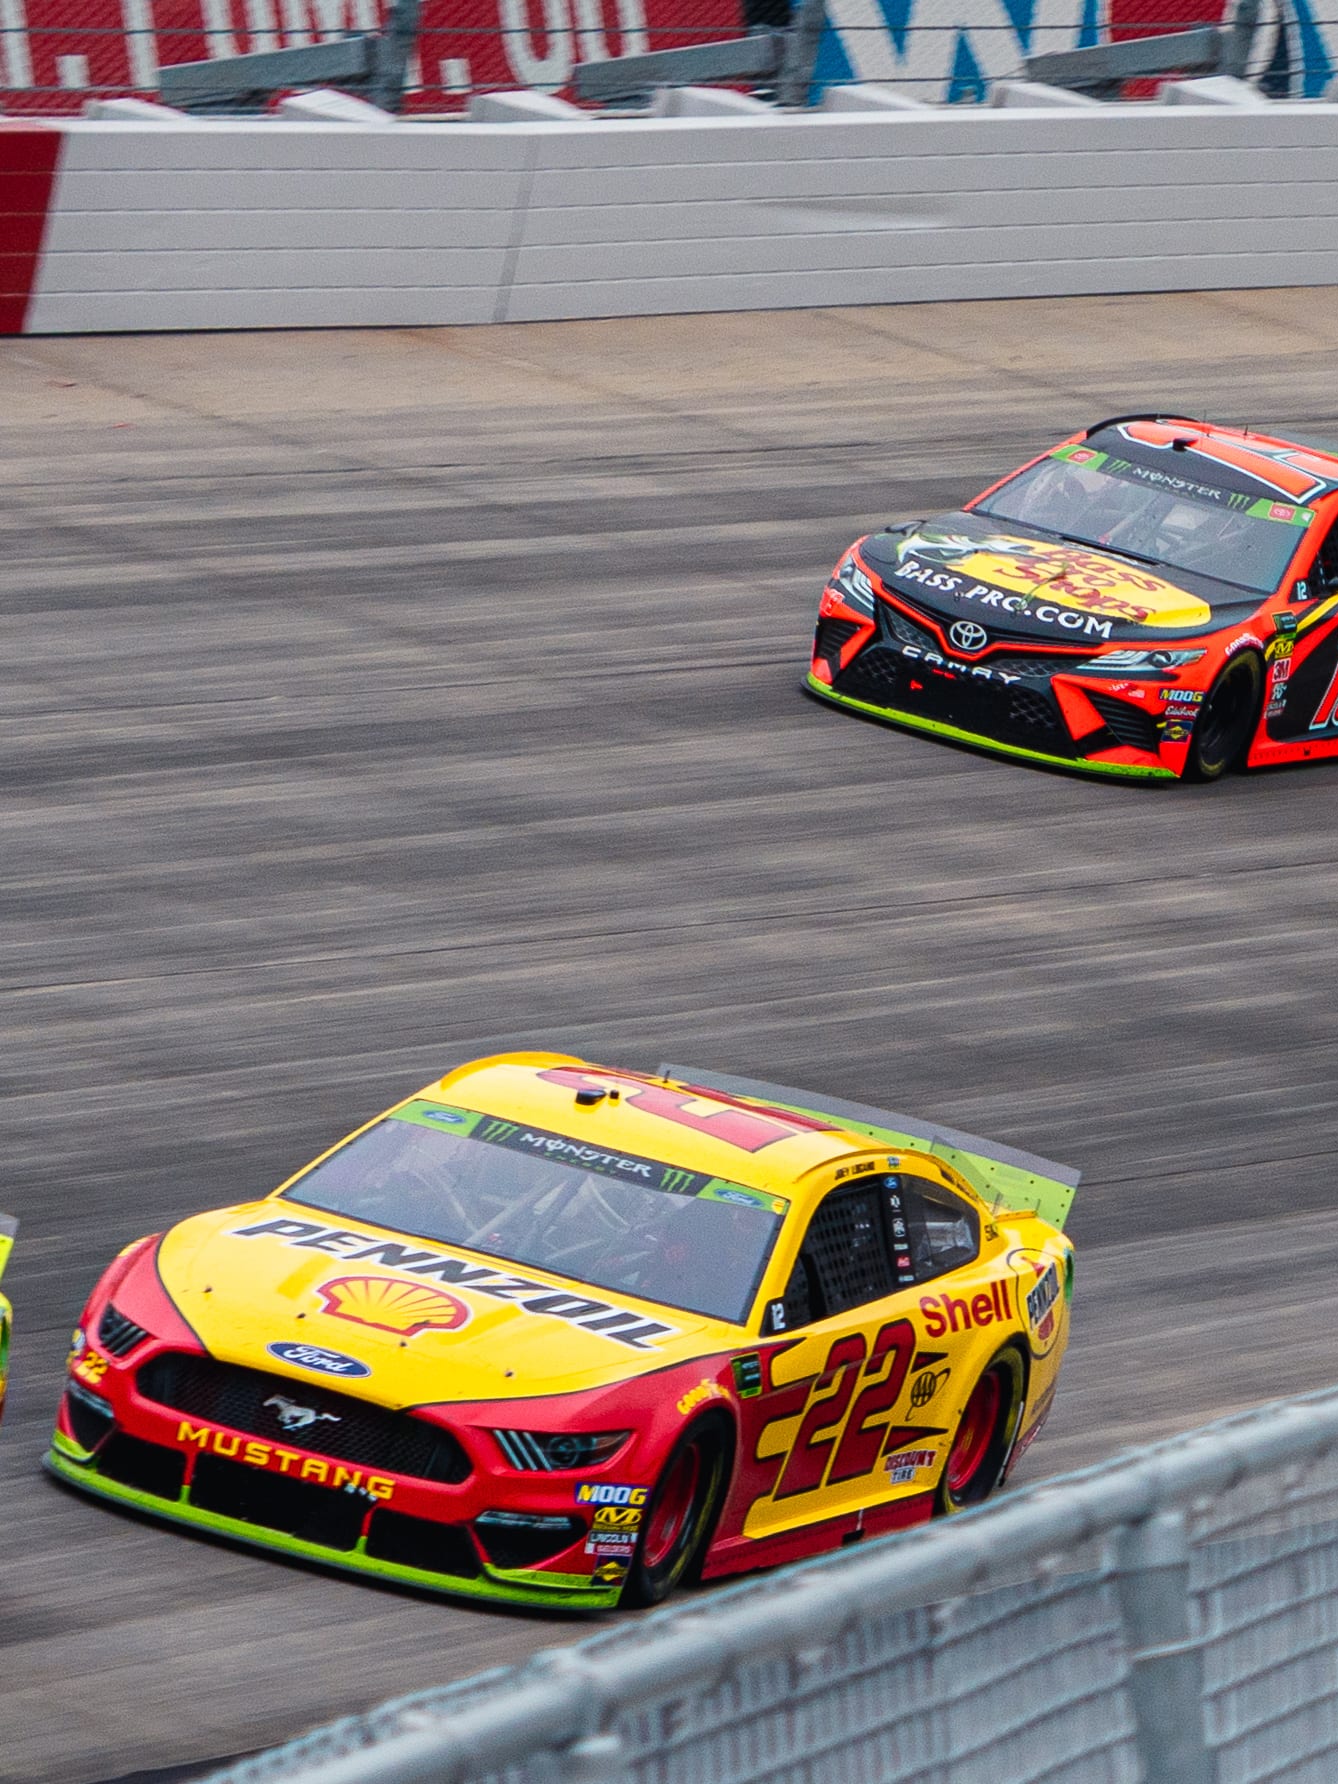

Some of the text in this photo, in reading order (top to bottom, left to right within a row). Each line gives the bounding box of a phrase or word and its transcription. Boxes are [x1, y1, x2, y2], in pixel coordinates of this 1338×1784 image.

[1132, 466, 1221, 500] MONSTER
[1043, 548, 1166, 592] Bass
[902, 645, 1021, 685] CAMRY
[1160, 689, 1203, 702] MOOG
[519, 1132, 652, 1177] MONSTER
[228, 1217, 677, 1351] PENNZOIL
[919, 1280, 1013, 1339] Shell
[75, 1351, 110, 1384] 22
[283, 1346, 354, 1372] Ford
[676, 1378, 733, 1416] GOOD
[772, 1317, 917, 1502] 22
[177, 1421, 395, 1500] MUSTANG
[885, 1450, 937, 1472] DISCOUNT
[891, 1466, 915, 1484] TIRE
[577, 1485, 648, 1505] MOOG
